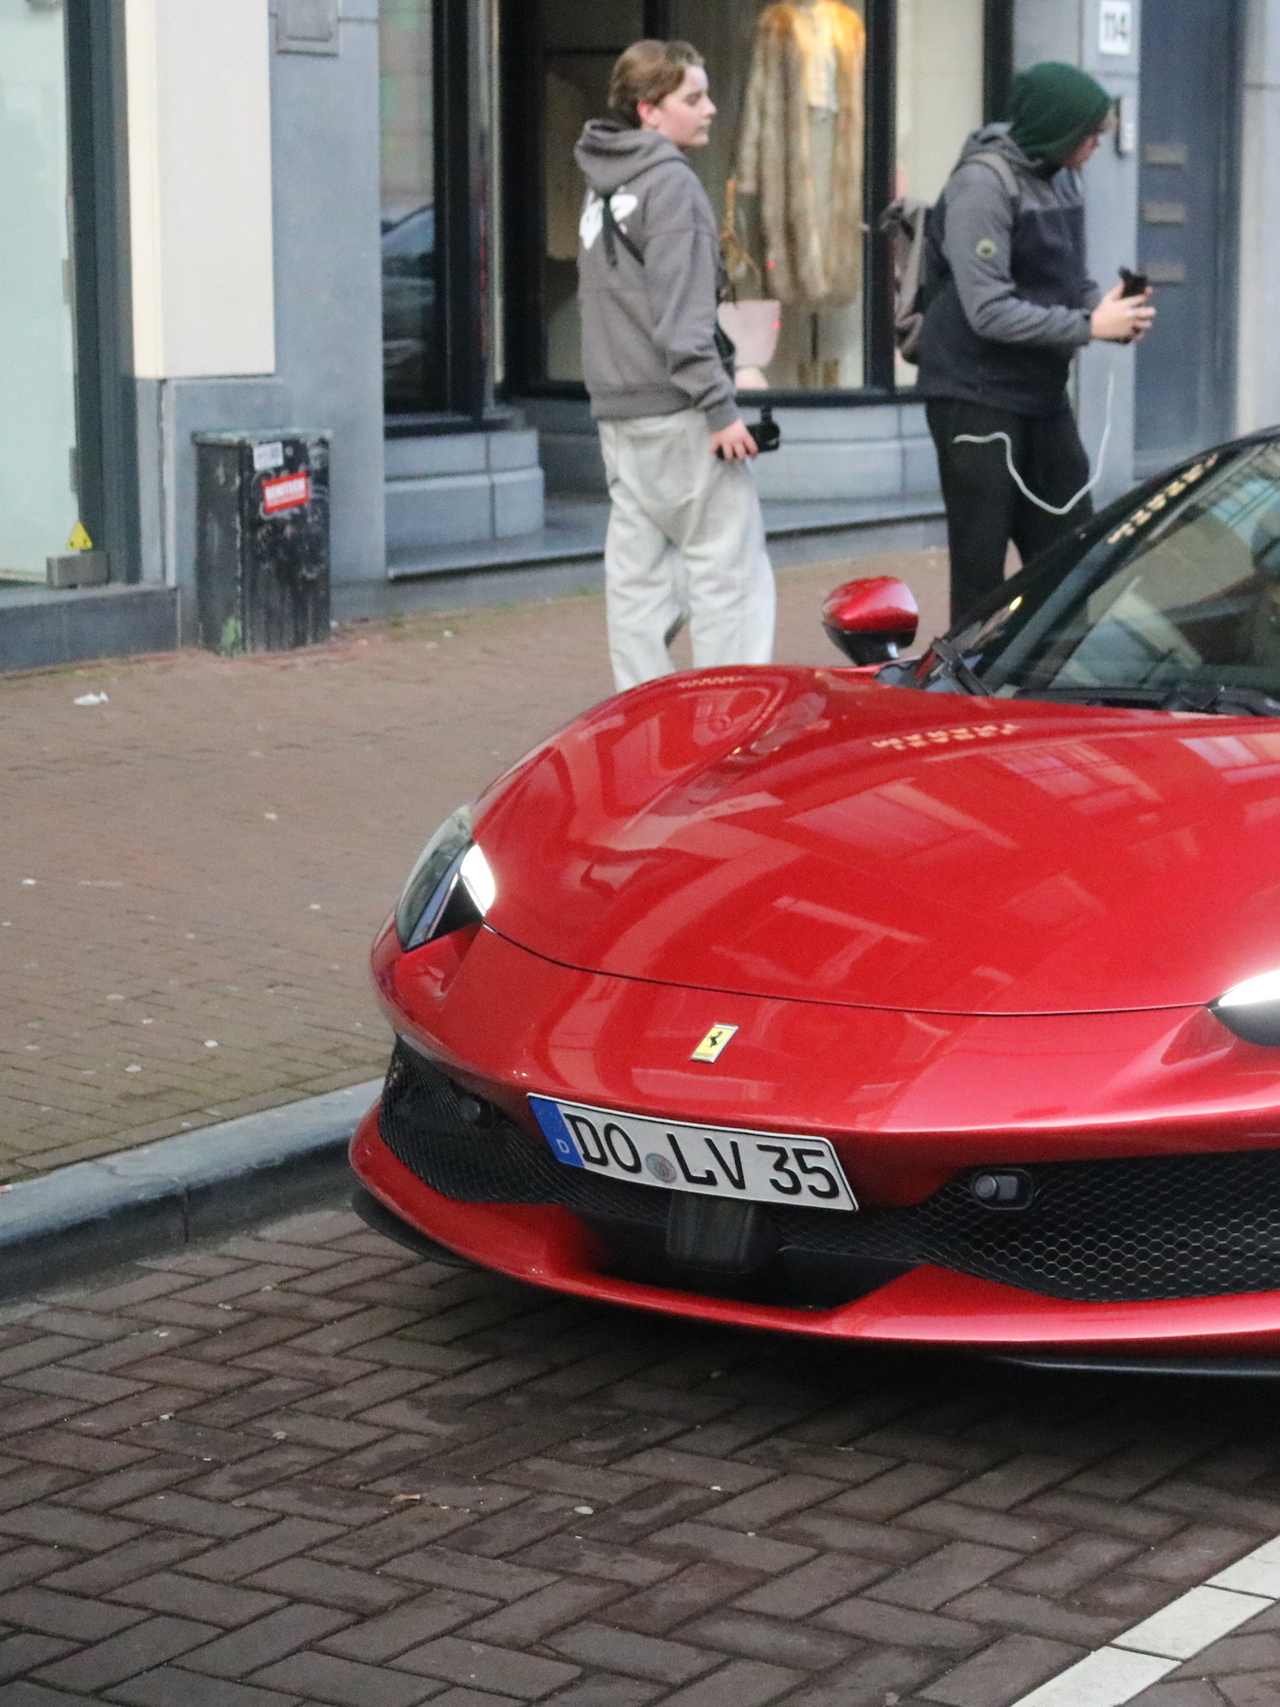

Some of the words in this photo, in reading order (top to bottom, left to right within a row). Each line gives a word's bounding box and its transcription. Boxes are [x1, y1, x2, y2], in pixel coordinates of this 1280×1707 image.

[556, 1139, 570, 1154] D
[563, 1112, 642, 1174] DO
[666, 1132, 746, 1191] LV
[756, 1143, 840, 1199] 35
